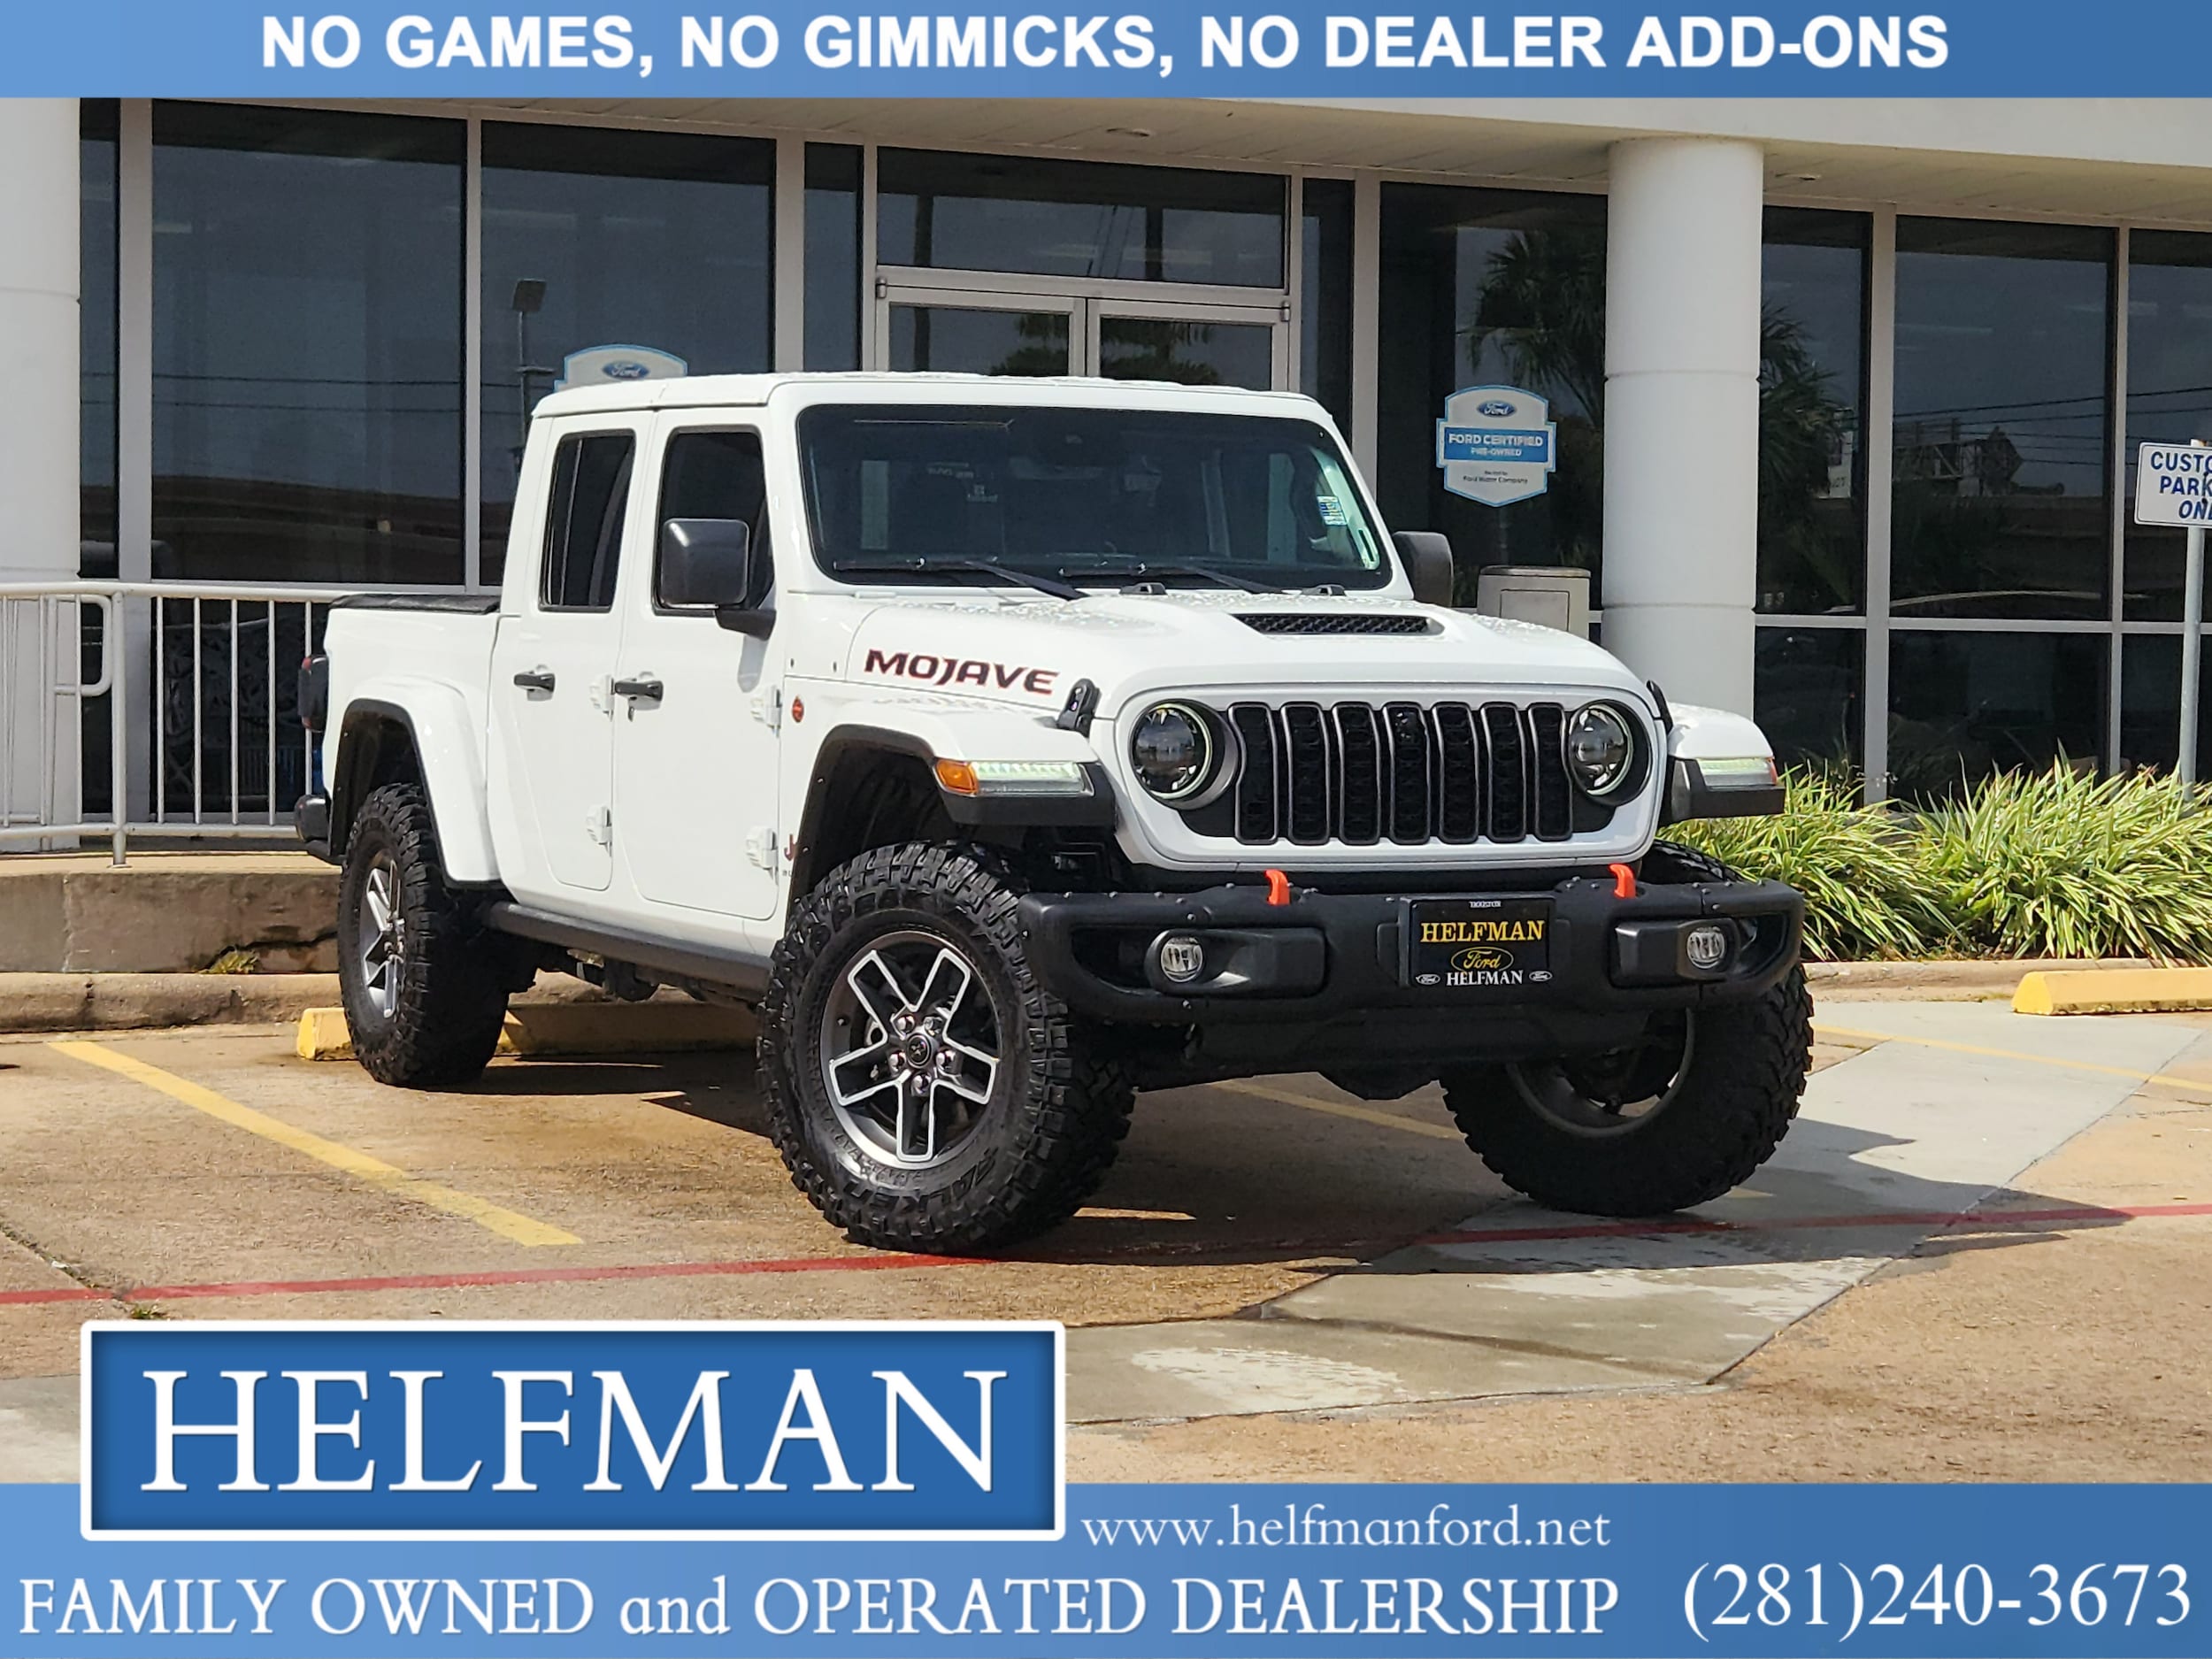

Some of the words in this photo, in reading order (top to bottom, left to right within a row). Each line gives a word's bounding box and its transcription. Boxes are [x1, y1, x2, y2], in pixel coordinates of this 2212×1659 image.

[1448, 433, 1482, 445] FORD
[1483, 434, 1544, 447] CERTIFIED
[1470, 447, 1523, 457] PRE-OWNED
[2159, 475, 2212, 497] PARK
[864, 649, 1061, 696] MOJAVE
[1419, 919, 1547, 943] HELFMAN
[1463, 949, 1502, 970] Ford
[1445, 969, 1525, 987] HELFMAN
